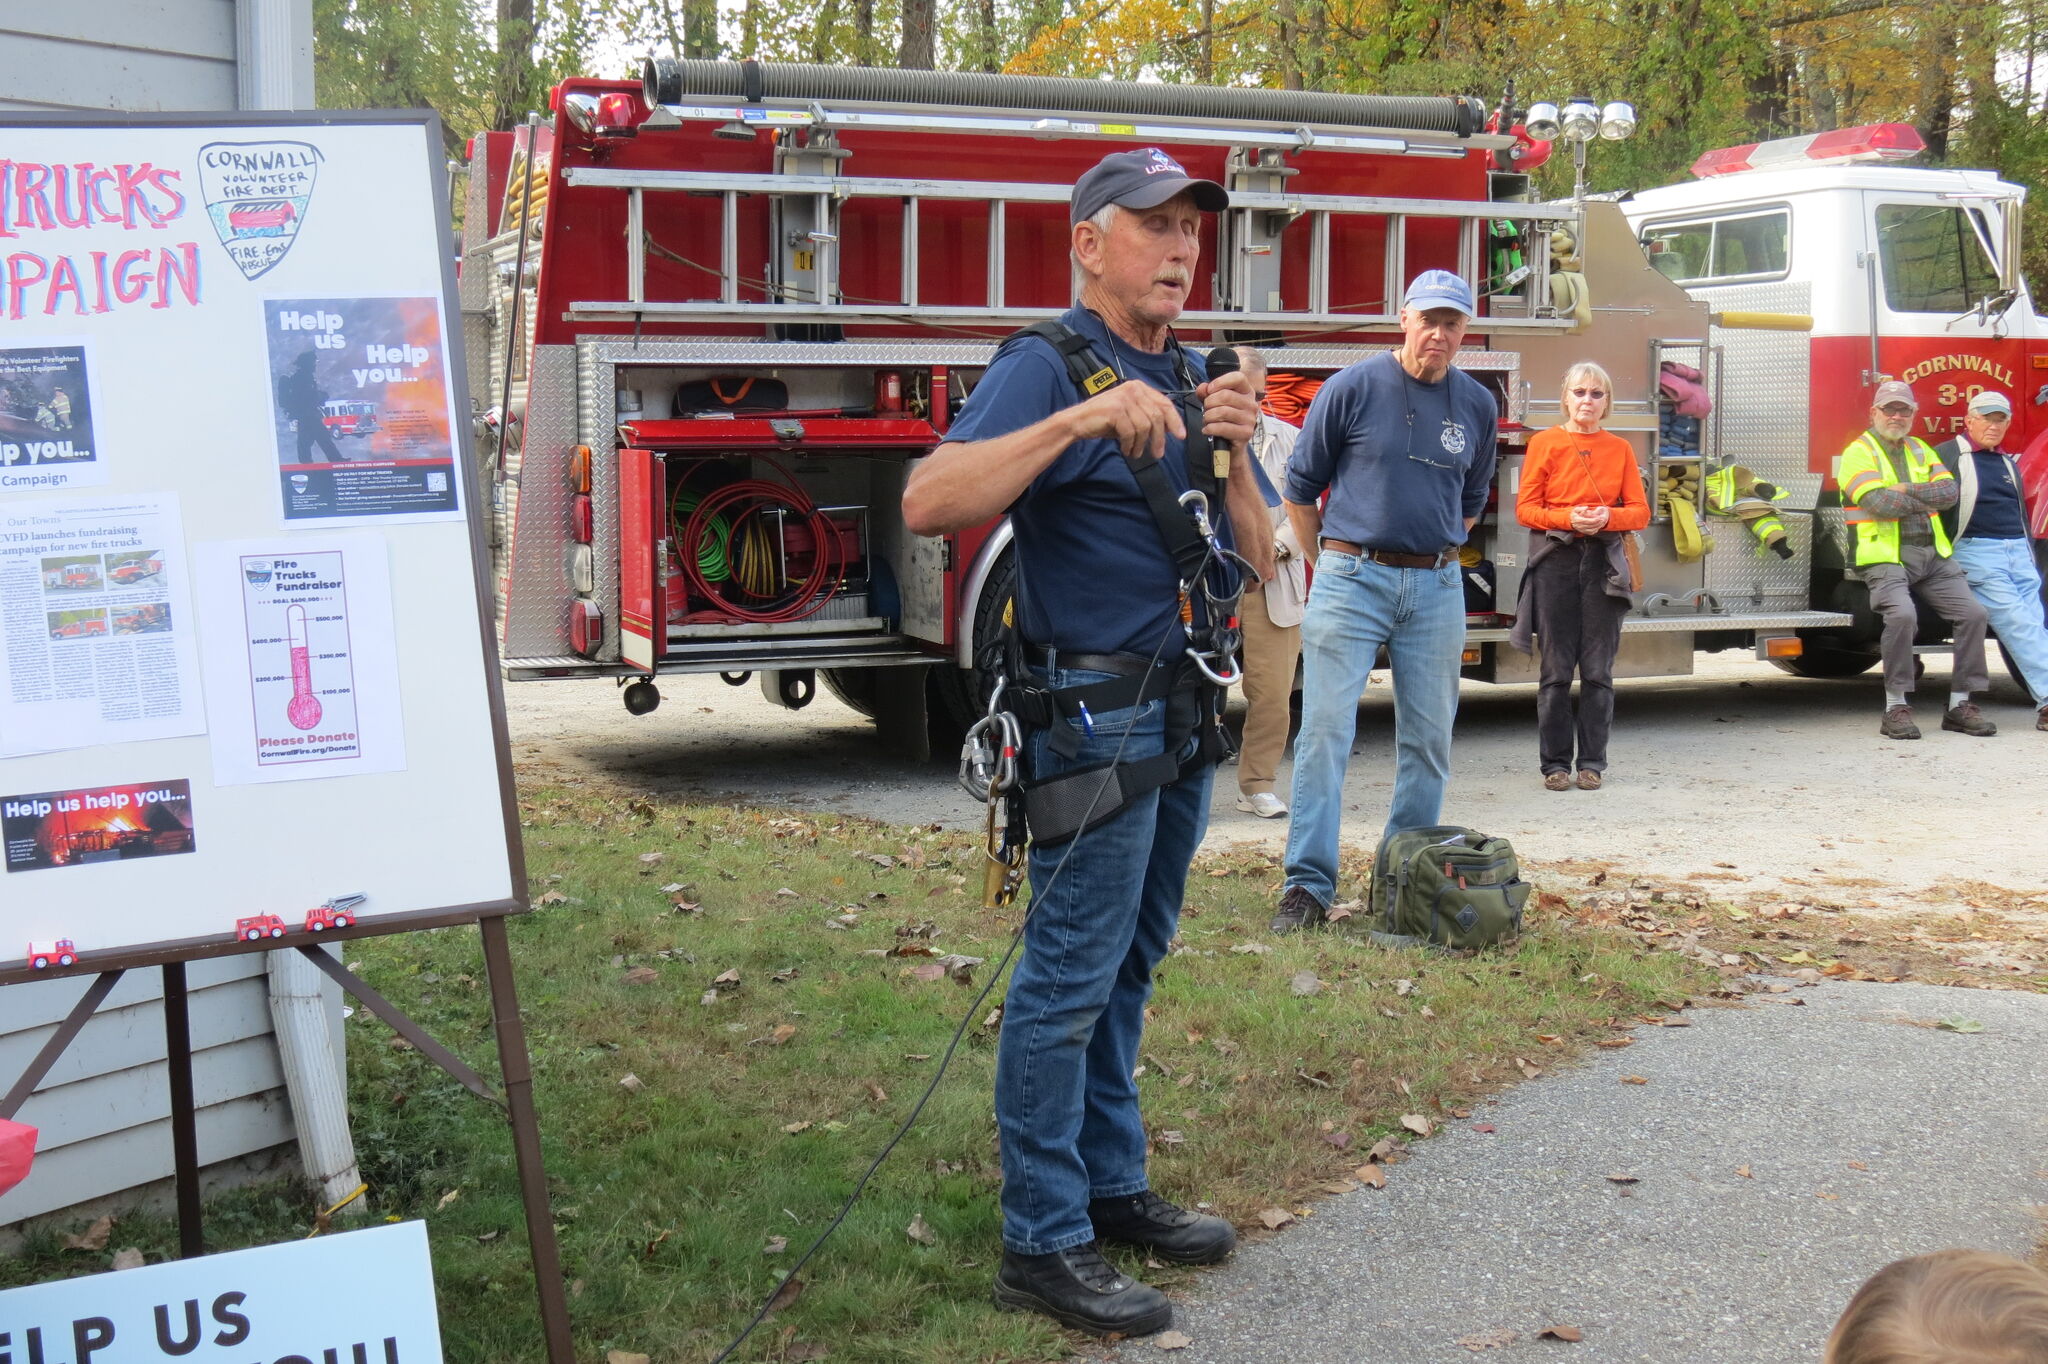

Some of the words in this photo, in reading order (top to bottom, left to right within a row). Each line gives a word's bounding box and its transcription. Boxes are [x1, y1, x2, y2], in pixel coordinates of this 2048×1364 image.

[206, 151, 316, 172] CORNWALL
[223, 172, 309, 184] VOLUNTEER
[223, 185, 254, 198] FIRE
[231, 246, 260, 259] FIRE
[0, 242, 203, 320] PAIGN
[279, 311, 344, 335] Help
[315, 333, 346, 349] us
[42, 355, 80, 363] Firefighters
[366, 343, 429, 367] Help
[33, 365, 67, 373] Equipment
[1902, 354, 2014, 388] CORNWALL
[352, 367, 418, 388] you...
[25, 440, 90, 464] you...
[2, 473, 67, 487] Campaign
[8, 519, 27, 527] Our
[30, 516, 61, 525] Towns
[32, 529, 76, 540] launches
[79, 526, 138, 538] fundraising
[0, 545, 47, 556] ampaign
[50, 543, 65, 552] for
[69, 543, 88, 551] new
[91, 540, 108, 549] fire
[111, 538, 143, 547] trucks
[274, 560, 297, 569] Fire
[275, 571, 316, 580] Trucks
[276, 580, 342, 592] Fundraiser
[259, 735, 304, 748] Please
[307, 732, 356, 744] Donate
[6, 800, 52, 818] Help
[57, 798, 80, 812] us
[86, 792, 129, 810] help
[135, 788, 186, 807] you...
[154, 1290, 251, 1356] US
